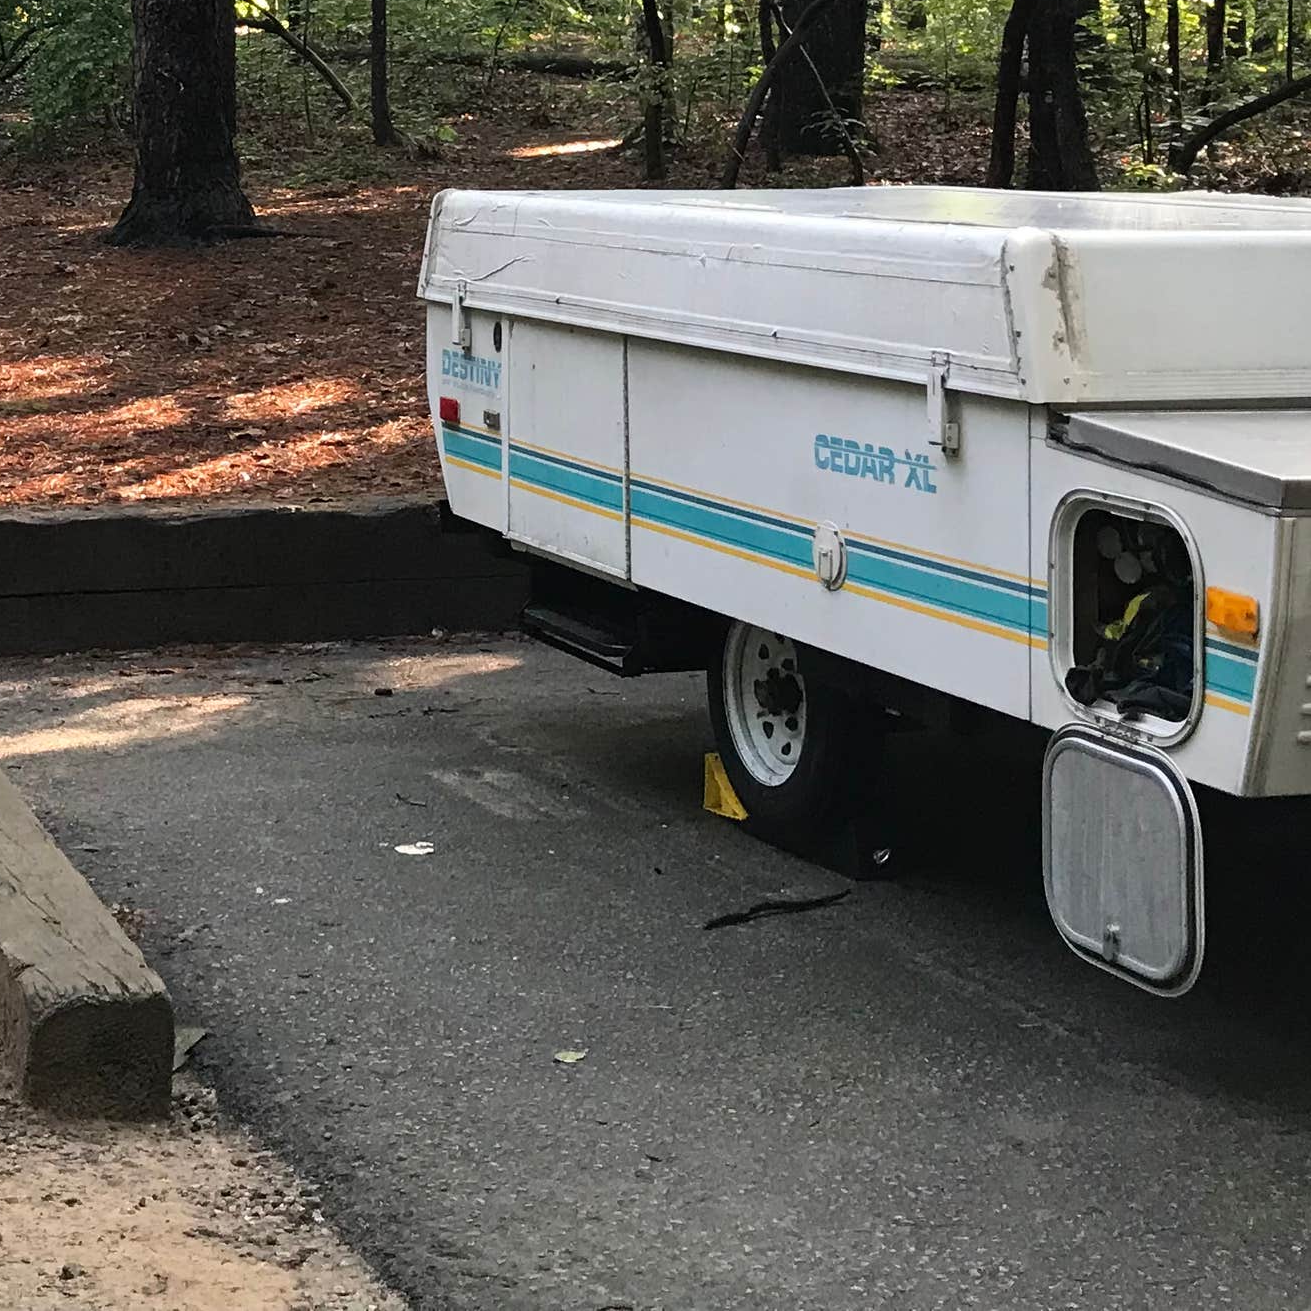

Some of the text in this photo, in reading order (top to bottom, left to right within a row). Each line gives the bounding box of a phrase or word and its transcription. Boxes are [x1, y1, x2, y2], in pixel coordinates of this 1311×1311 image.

[442, 349, 502, 388] DESTINY
[815, 434, 937, 494] CEDAR XL
